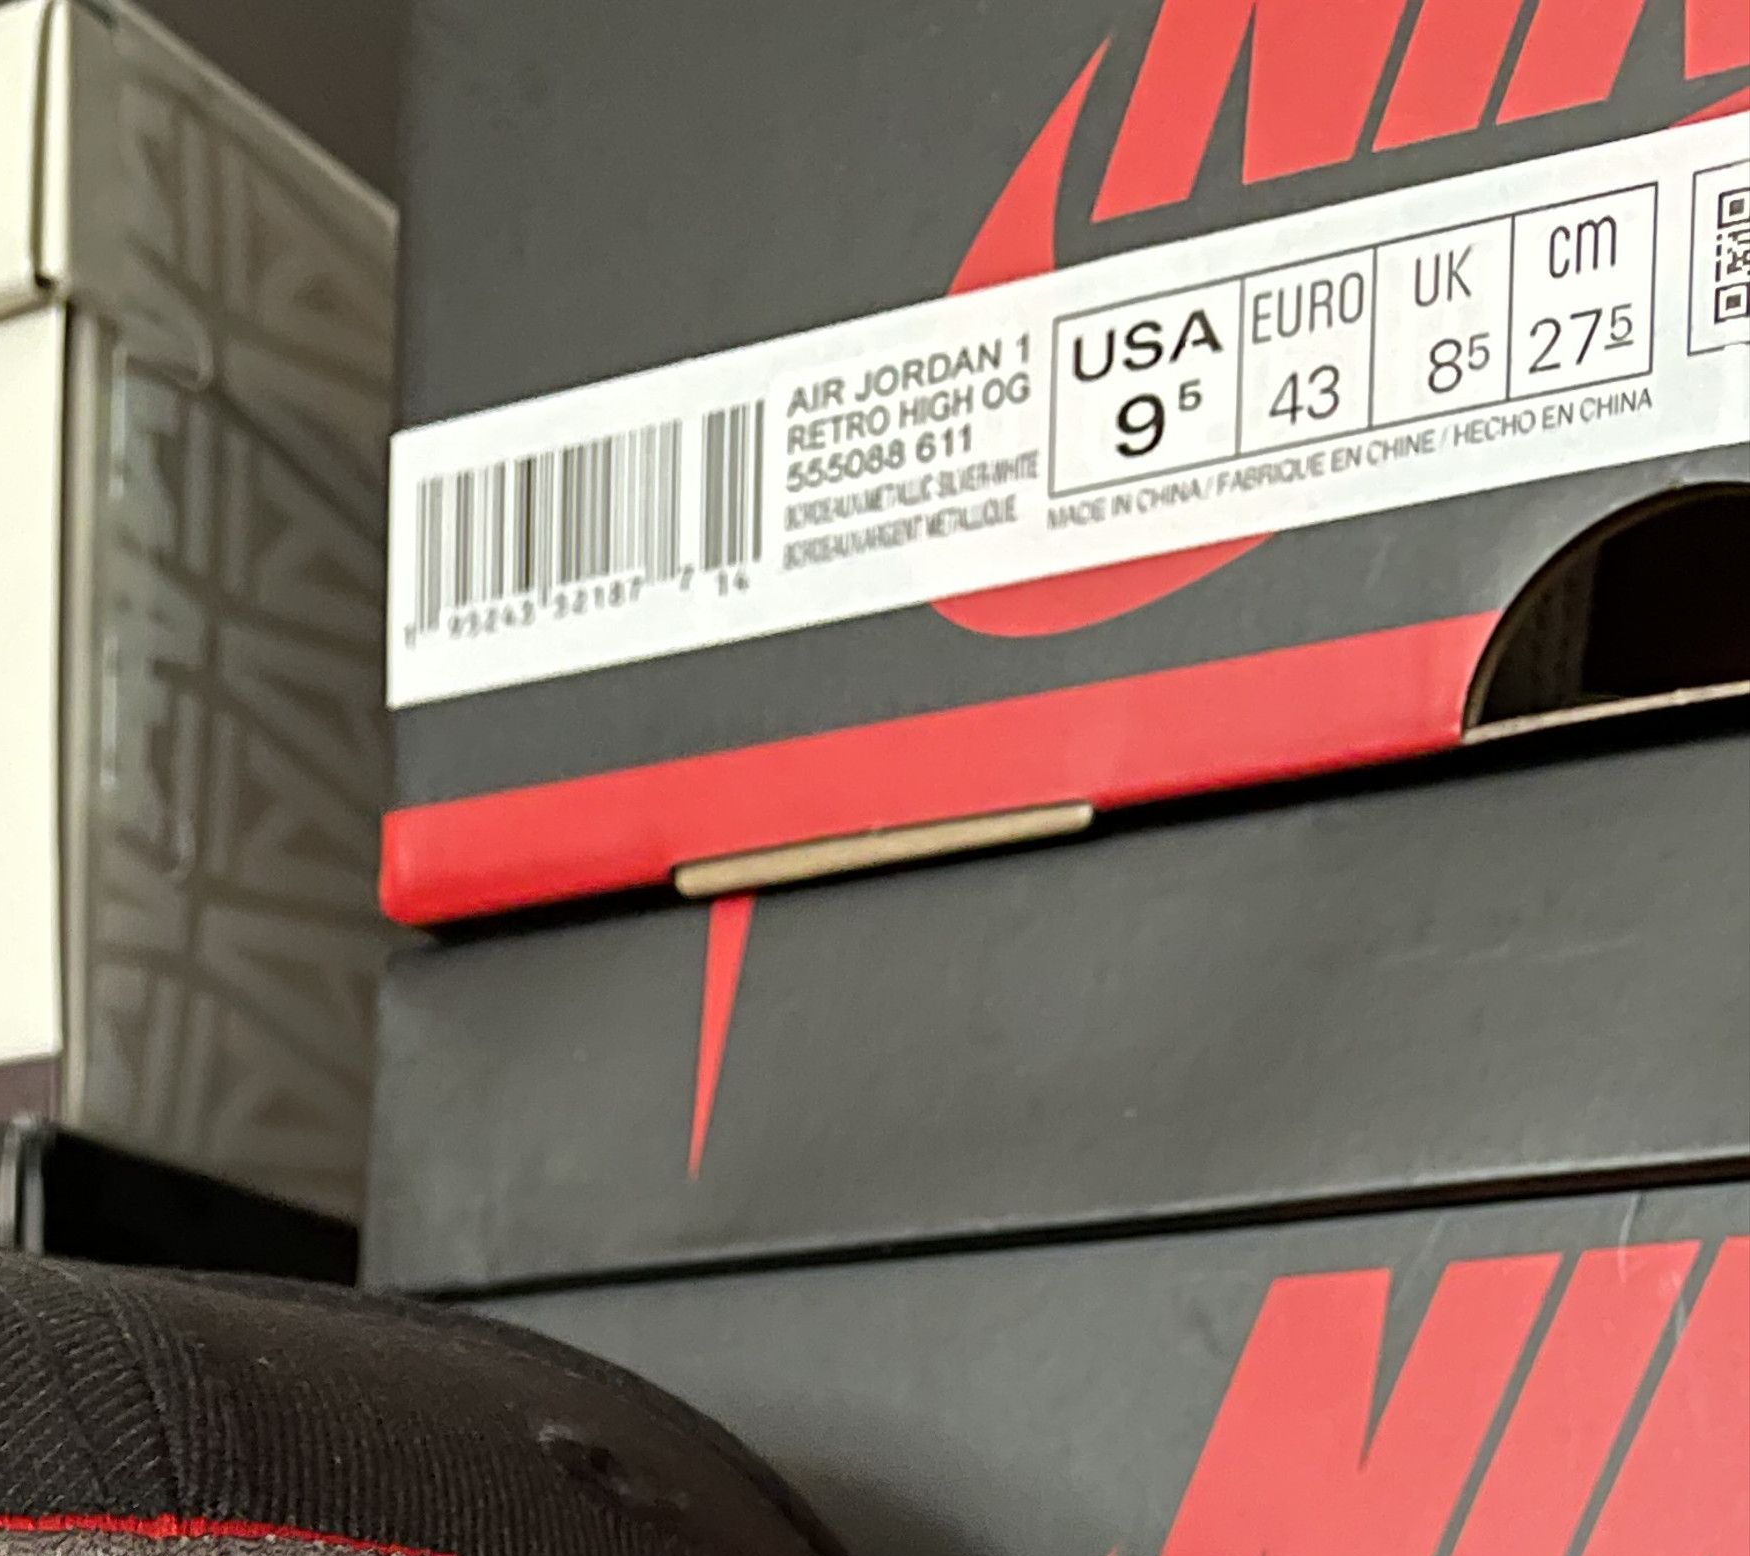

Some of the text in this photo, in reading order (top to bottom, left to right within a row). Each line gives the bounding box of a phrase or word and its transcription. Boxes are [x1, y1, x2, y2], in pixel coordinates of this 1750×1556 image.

[1414, 244, 1474, 307] UK
[1548, 213, 1617, 280] cm
[1072, 309, 1224, 383] USA
[1251, 272, 1366, 346] EURO
[787, 331, 1030, 418] AIR JORDAN 1
[1268, 364, 1341, 426] 43
[787, 372, 1030, 455] RETRO HIGH OG
[787, 422, 972, 493] 555088 611
[1047, 495, 1107, 532] MADE
[1111, 490, 1131, 517] IN
[1133, 472, 1200, 515] CHINA
[1215, 451, 1327, 496] FABRIQUE
[1330, 444, 1362, 474] EN
[1366, 429, 1437, 467] CHINE
[1453, 411, 1536, 449] HECHO
[1541, 403, 1575, 430] EN
[1580, 386, 1653, 423] CHINA
